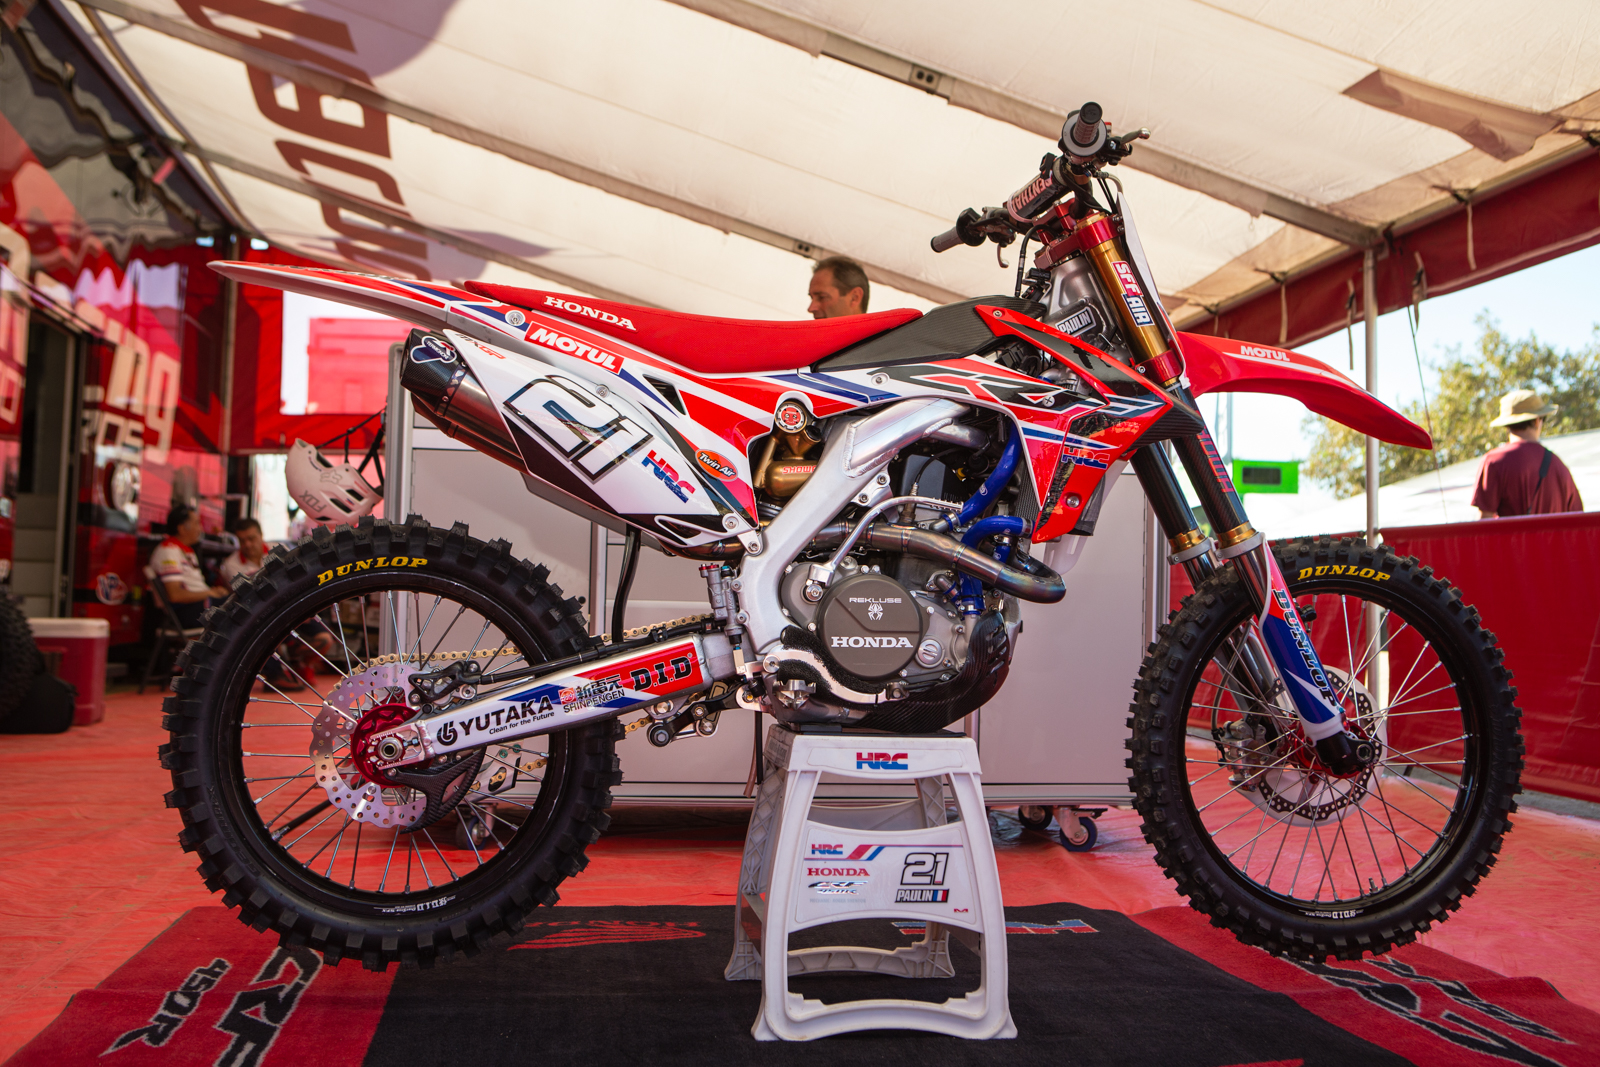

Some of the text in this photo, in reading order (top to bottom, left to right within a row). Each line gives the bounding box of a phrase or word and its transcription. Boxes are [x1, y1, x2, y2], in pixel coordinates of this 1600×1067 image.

[1113, 262, 1153, 326] SFF AIR
[543, 295, 637, 331] HONDA
[1058, 311, 1092, 335] PAULIN
[529, 327, 617, 370] MOTUL
[1240, 345, 1290, 362] MOTUL
[503, 374, 654, 484] 21
[698, 452, 736, 478] Twin Air
[1061, 446, 1111, 470] HRC
[1199, 423, 1235, 493] HOWA
[641, 449, 696, 504] HRC
[299, 490, 328, 513] FOX
[317, 556, 428, 586] DUNLOP
[1297, 564, 1391, 581] DUNLOP
[831, 636, 913, 648] HONDA
[1273, 589, 1338, 707] DUNLOP
[563, 688, 626, 714] SHINDENGEN
[458, 694, 555, 736] YUTAKA
[489, 712, 555, 735] Clean for the Future
[856, 752, 909, 770] HRC
[811, 844, 843, 855] HRC
[807, 867, 870, 877] HONDA
[900, 852, 950, 886] 21
[897, 889, 933, 902] PAULIN
